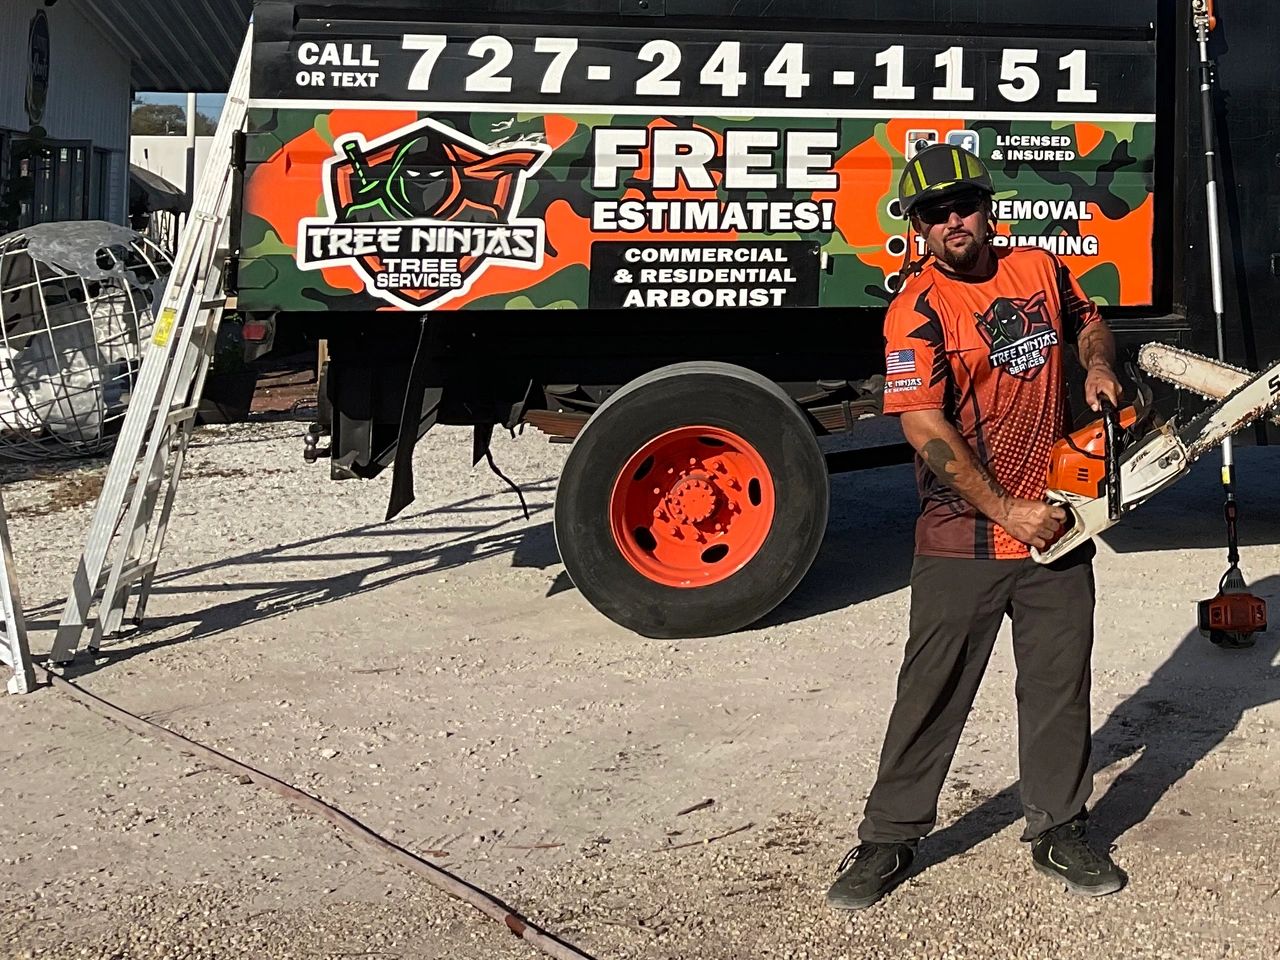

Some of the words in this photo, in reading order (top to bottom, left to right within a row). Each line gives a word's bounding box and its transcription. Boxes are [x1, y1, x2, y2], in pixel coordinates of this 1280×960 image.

[298, 41, 380, 67] CALL
[296, 71, 325, 86] OR
[331, 71, 379, 88] TEXT
[996, 136, 1071, 146] LICENSED
[595, 129, 838, 190] FREE
[991, 150, 1003, 160] &
[1008, 150, 1076, 160] INSURED
[594, 201, 835, 231] ESTIMATES!
[307, 227, 402, 258] TREE
[411, 227, 536, 258] NINJAS
[992, 236, 1098, 255] RIMMING
[624, 248, 788, 262] COMMERCIAL
[383, 259, 458, 272] TREE
[377, 273, 462, 288] SERVICES
[614, 269, 633, 283] &
[641, 269, 797, 283] RESIDENTIAL
[623, 289, 787, 308] ARBORIST
[990, 348, 1016, 366] TREE
[1018, 332, 1058, 355] NINJAS
[1010, 350, 1040, 366] TREE
[1009, 356, 1045, 375] SERVICES
